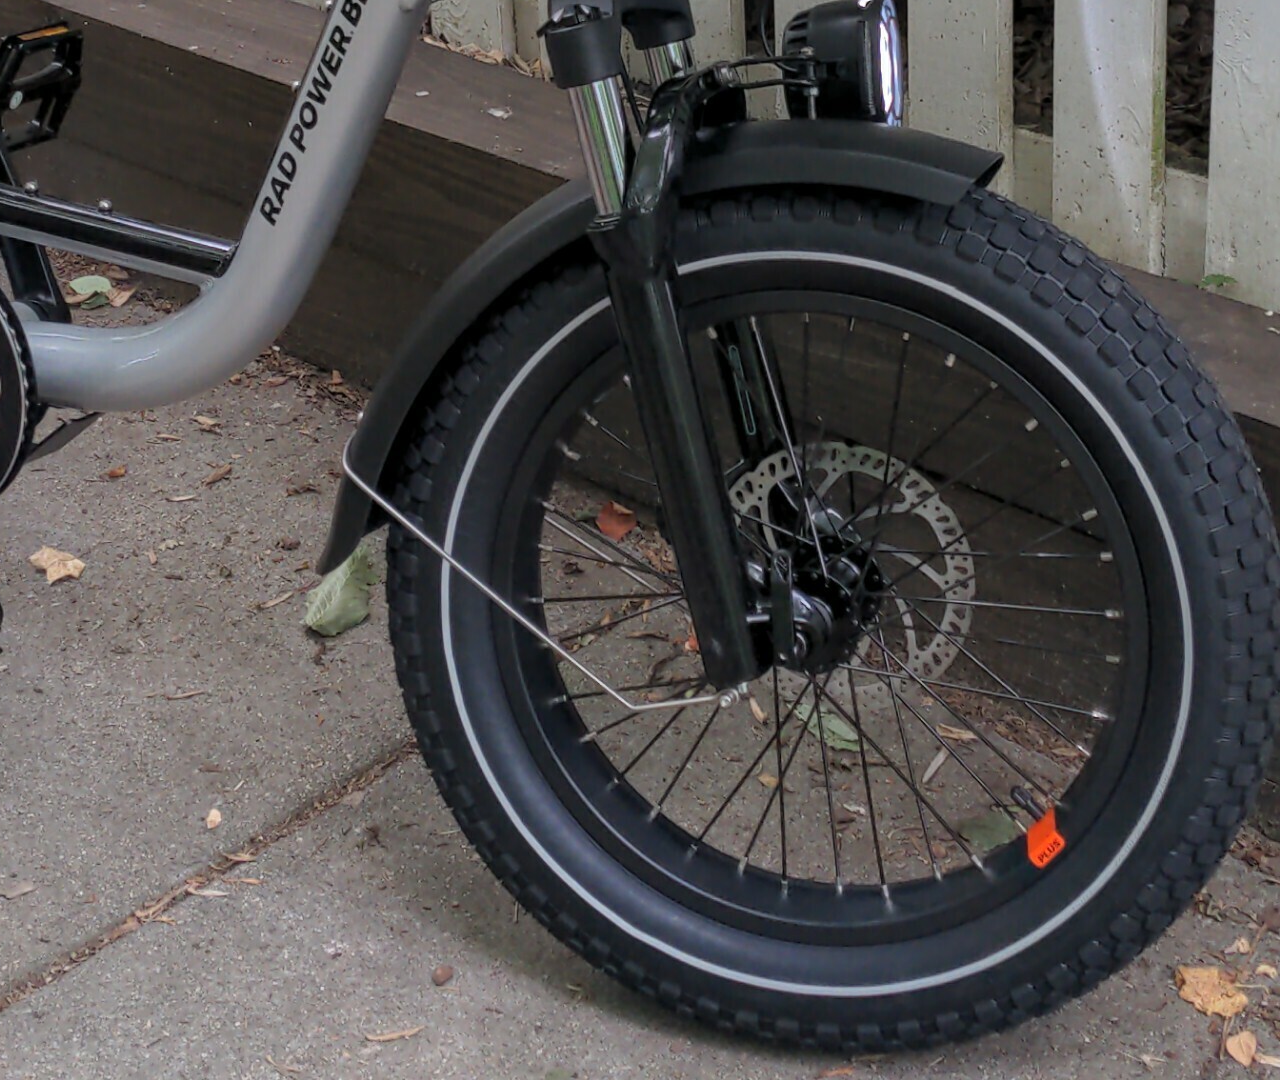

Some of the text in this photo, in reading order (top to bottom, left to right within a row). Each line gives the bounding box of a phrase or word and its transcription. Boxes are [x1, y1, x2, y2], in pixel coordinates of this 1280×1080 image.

[260, 151, 298, 227] RAD
[289, 25, 352, 154] POWER
[1037, 839, 1061, 864] PLUS
